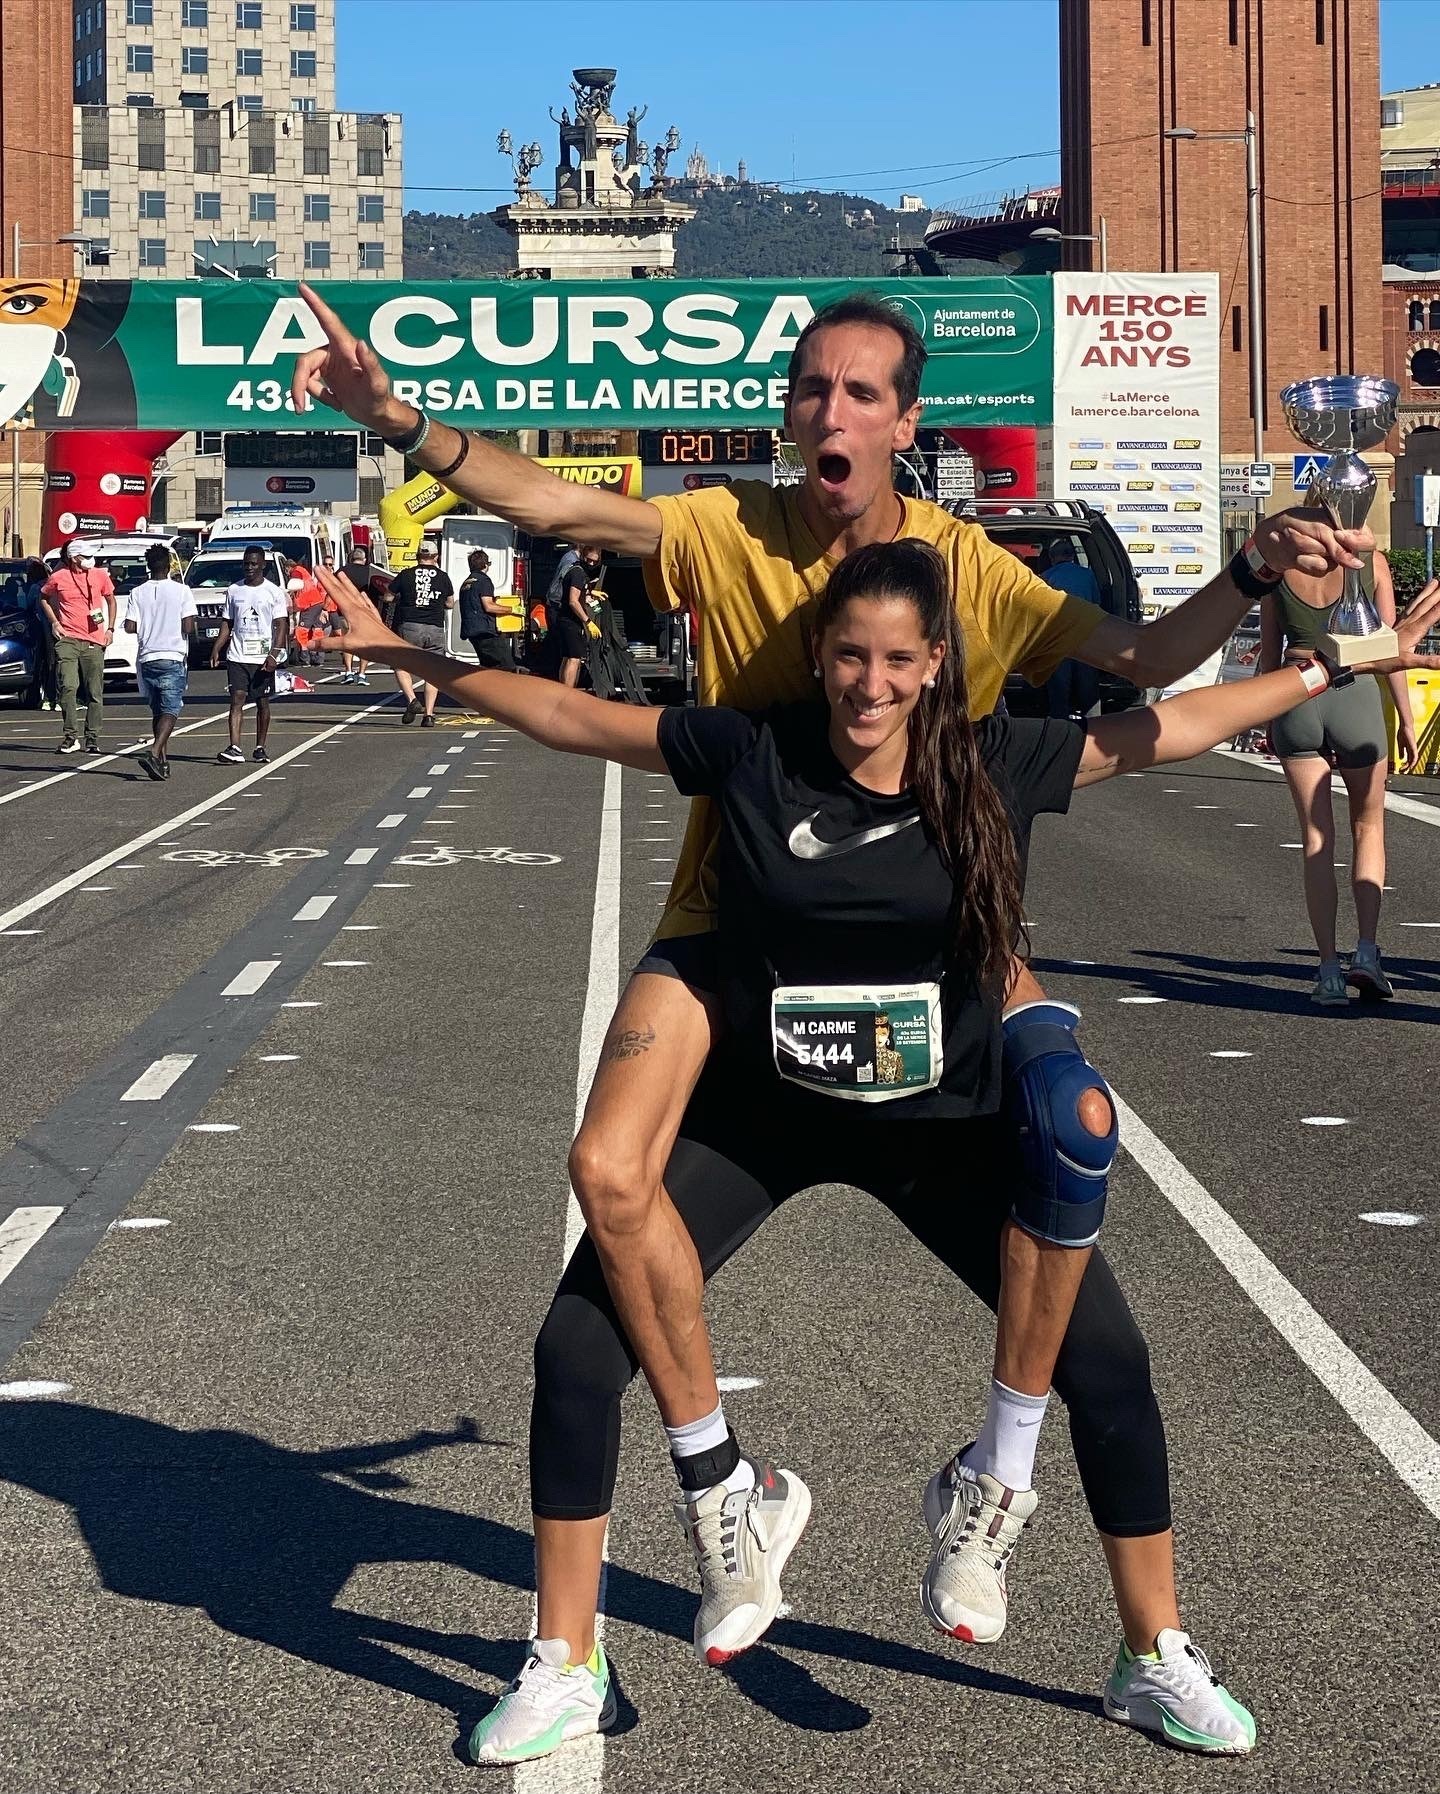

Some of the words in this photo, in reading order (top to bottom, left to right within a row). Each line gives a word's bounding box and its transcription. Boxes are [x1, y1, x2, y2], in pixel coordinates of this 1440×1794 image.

[1066, 289, 1208, 317] MERCÈ
[934, 310, 999, 322] Ajuntament
[1001, 309, 1016, 319] de
[176, 297, 331, 366] LA
[369, 295, 818, 366] CURSA
[933, 323, 1017, 338] Barcelona
[1099, 320, 1173, 342] 150
[1080, 346, 1192, 368] ANYS
[393, 380, 485, 411] RSA
[497, 380, 556, 410] DE
[566, 379, 622, 409] LA
[633, 371, 789, 409] MERCÈ
[917, 393, 1036, 407] ona.cat/esports
[1071, 406, 1201, 417] lamerce.barcelona
[407, 484, 440, 509] MUNDO
[415, 568, 437, 577] CRO
[416, 583, 432, 591] ME
[416, 591, 441, 599] TRAT
[793, 1021, 806, 1035] M
[808, 1021, 857, 1035] CARME
[797, 1043, 855, 1065] 5444
